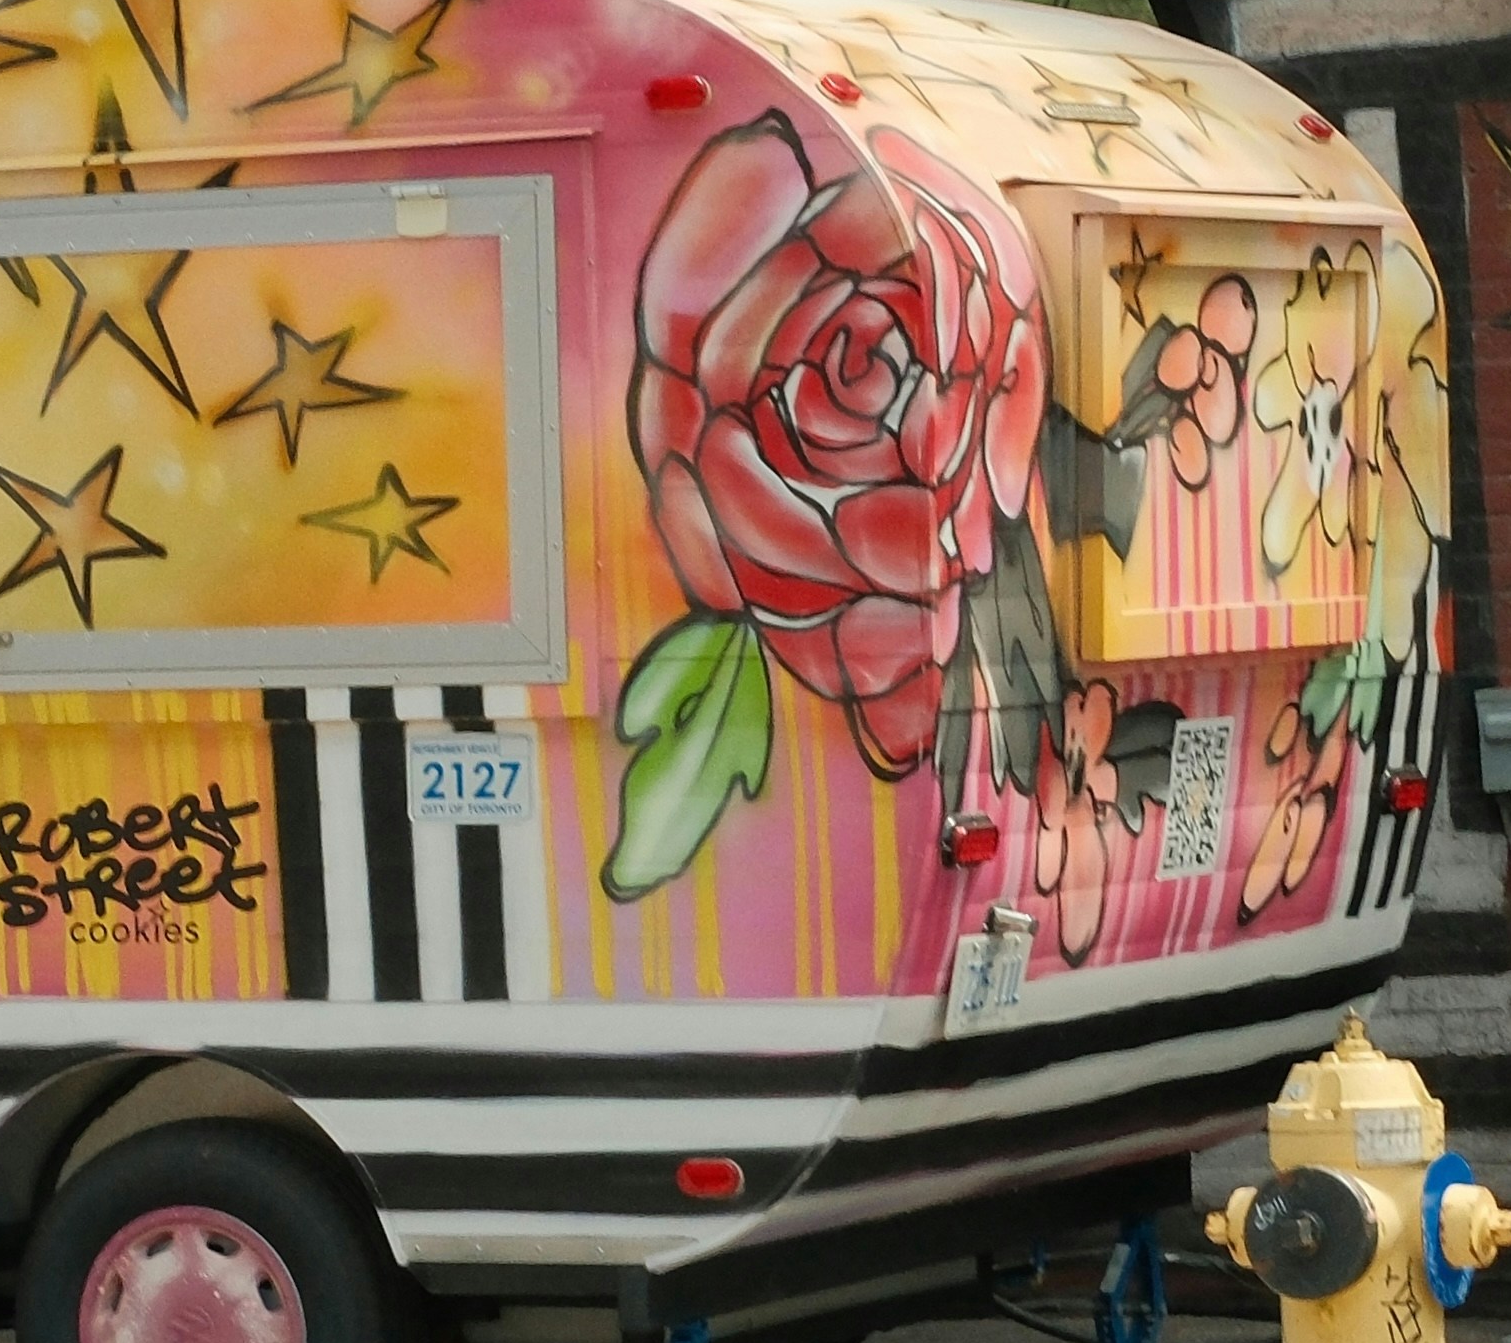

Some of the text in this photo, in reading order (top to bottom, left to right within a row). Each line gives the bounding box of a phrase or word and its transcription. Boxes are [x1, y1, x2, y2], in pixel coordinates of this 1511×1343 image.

[422, 761, 521, 799] 2127
[420, 803, 445, 815] CITY
[467, 802, 523, 814] TORONTO
[69, 904, 200, 945] cookies
